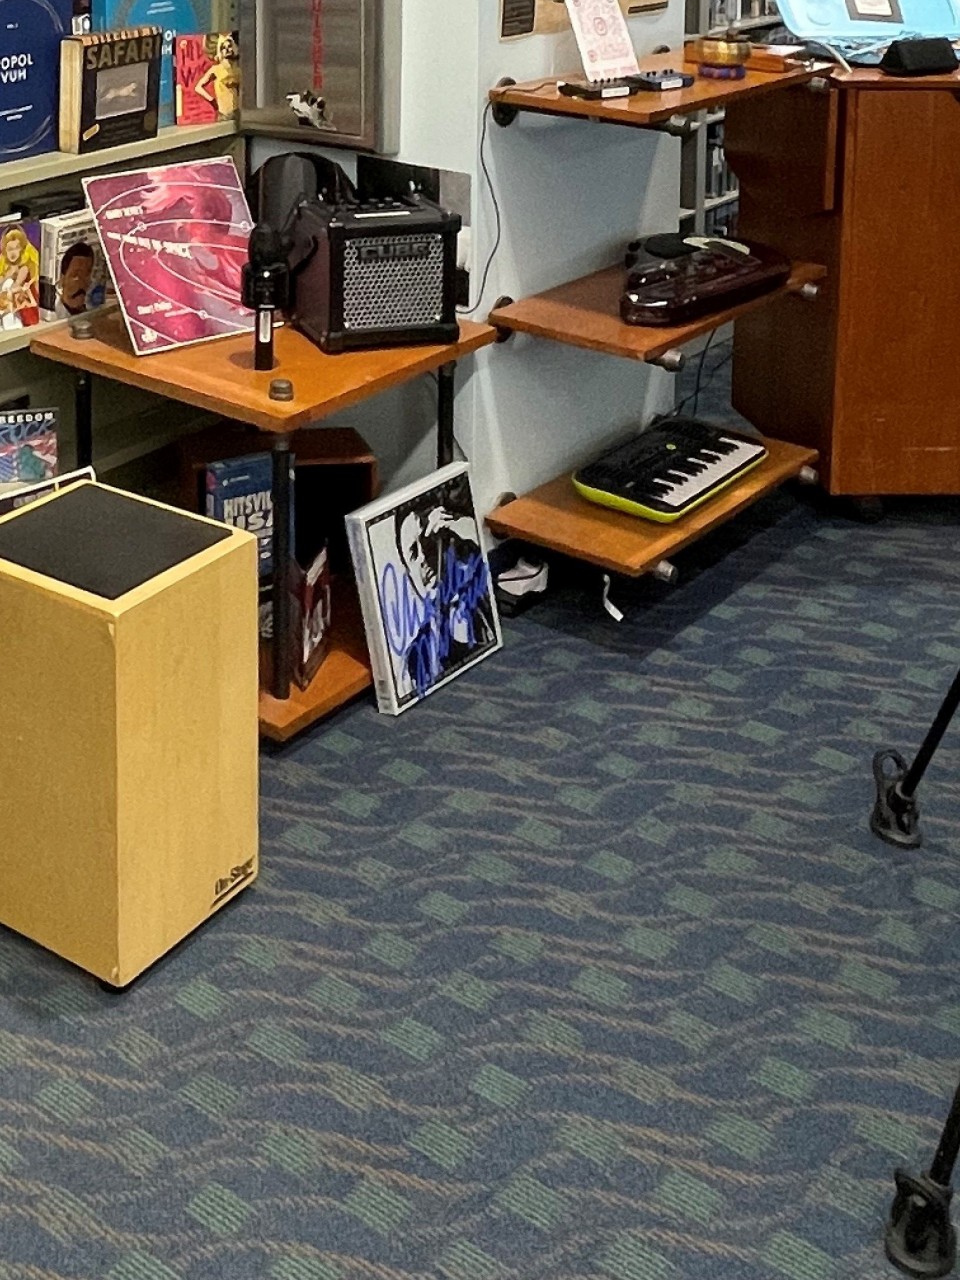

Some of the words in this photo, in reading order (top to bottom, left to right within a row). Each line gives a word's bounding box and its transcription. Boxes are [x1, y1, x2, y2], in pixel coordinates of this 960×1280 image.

[86, 35, 161, 70] SAFARI
[0, 70, 27, 84] VUH
[360, 241, 430, 261] CUBE
